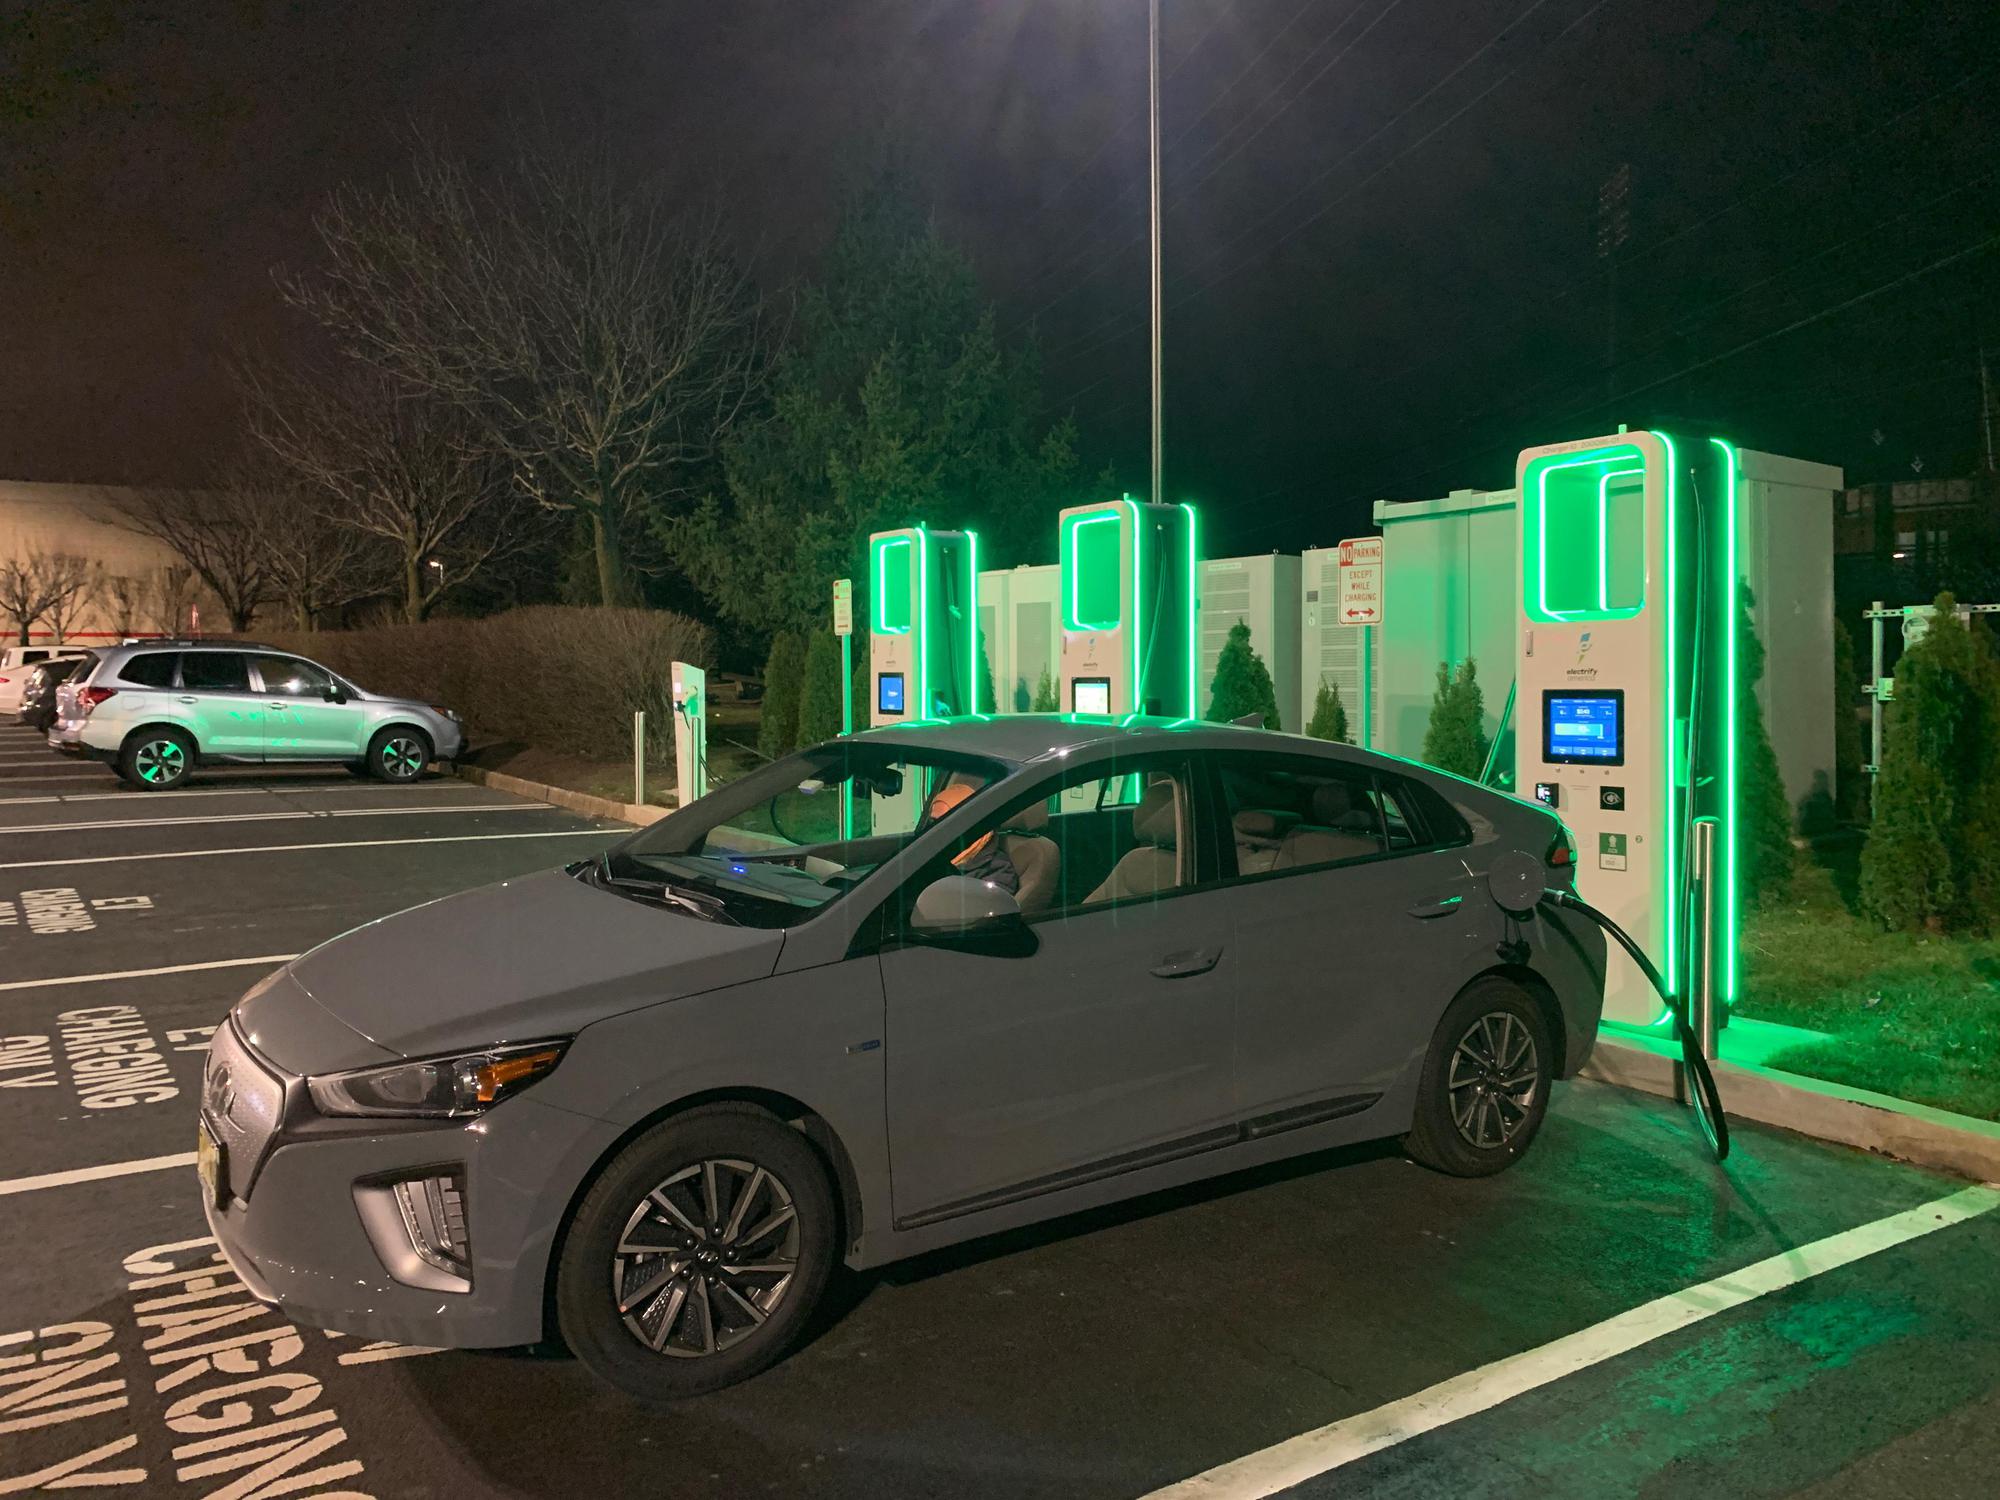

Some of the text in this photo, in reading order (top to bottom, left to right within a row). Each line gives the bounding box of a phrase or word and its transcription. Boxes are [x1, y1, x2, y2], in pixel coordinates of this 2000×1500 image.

[1340, 546, 1352, 563] NO
[1353, 546, 1380, 559] PARKING
[1349, 570, 1373, 580] EXCEPT
[1351, 581, 1370, 591] WHILE
[1345, 593, 1377, 602] CHARGING
[56, 1005, 180, 1109] CHARGING
[122, 1236, 377, 1500] CHARGIN
